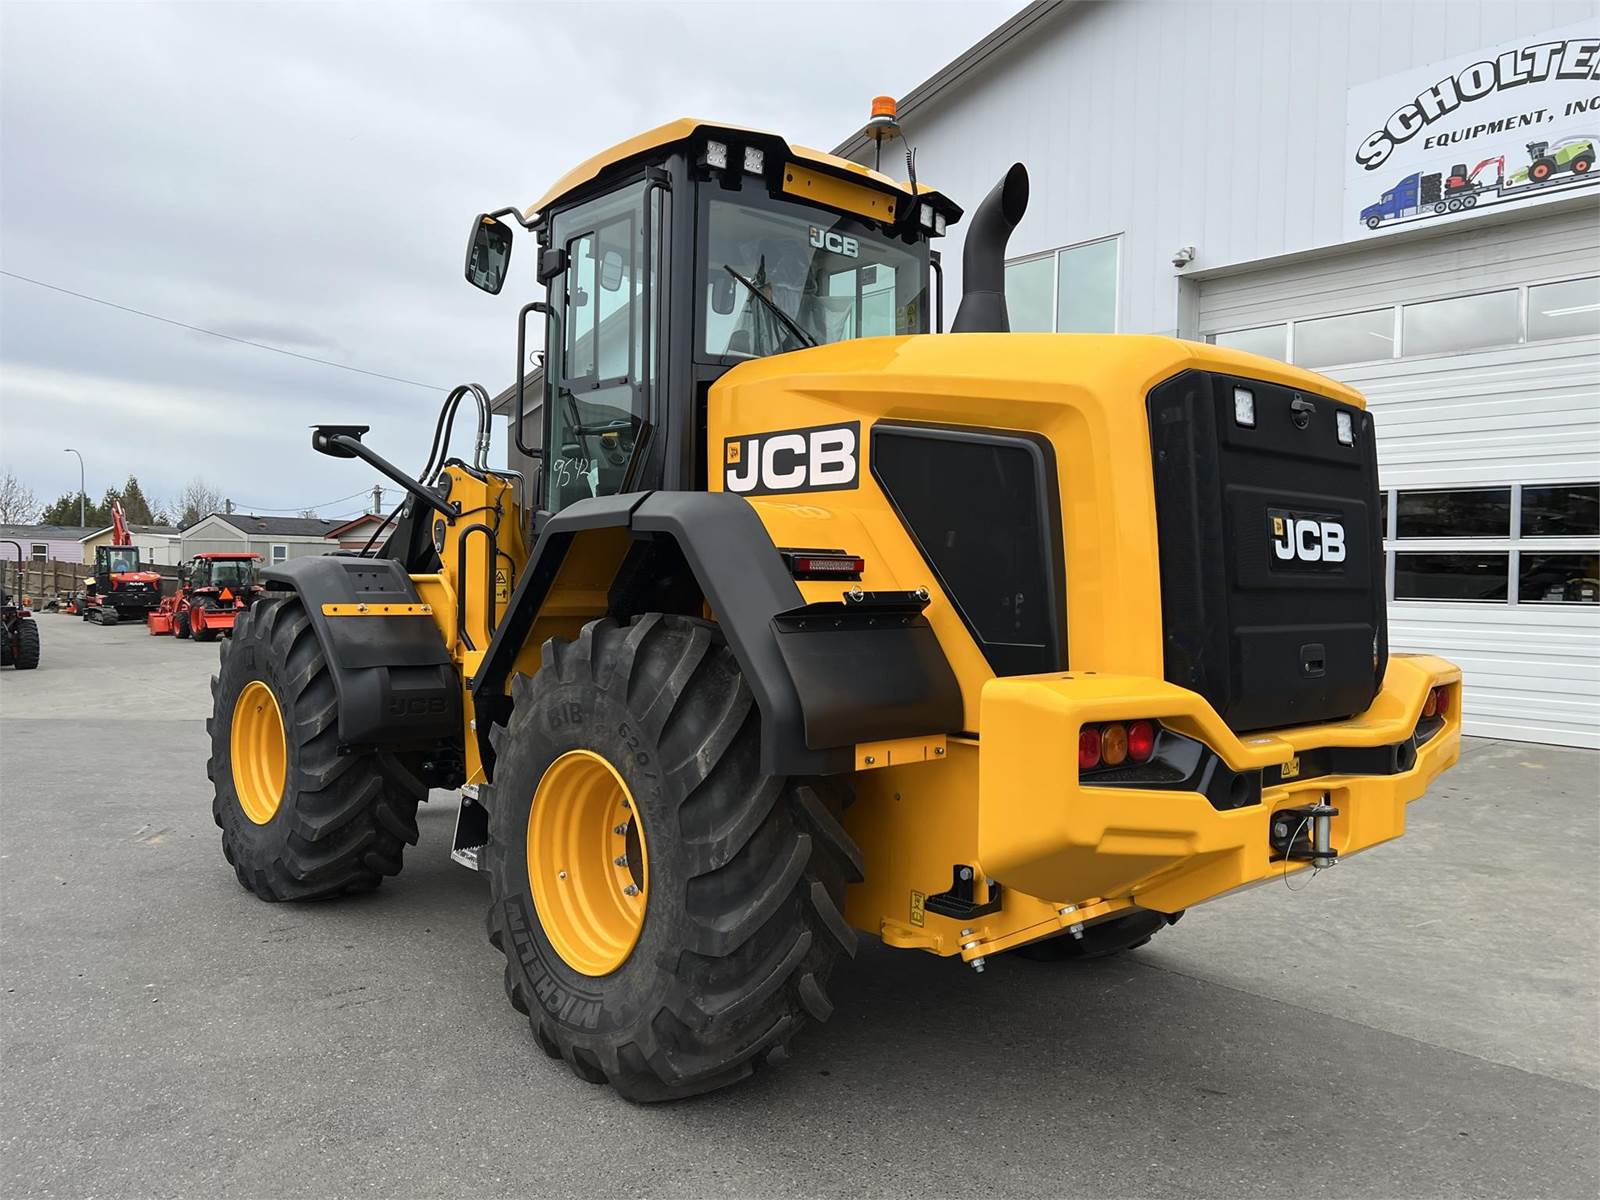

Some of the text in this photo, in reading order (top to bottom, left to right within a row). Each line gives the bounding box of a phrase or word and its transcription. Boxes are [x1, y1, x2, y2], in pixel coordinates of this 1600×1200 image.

[1424, 108, 1554, 149] EQUIPMENT,
[810, 229, 859, 258] JCB
[726, 428, 856, 492] JCB
[1275, 518, 1346, 562] JCB
[391, 697, 449, 718] JCB
[505, 901, 603, 1030] MICHELIN
